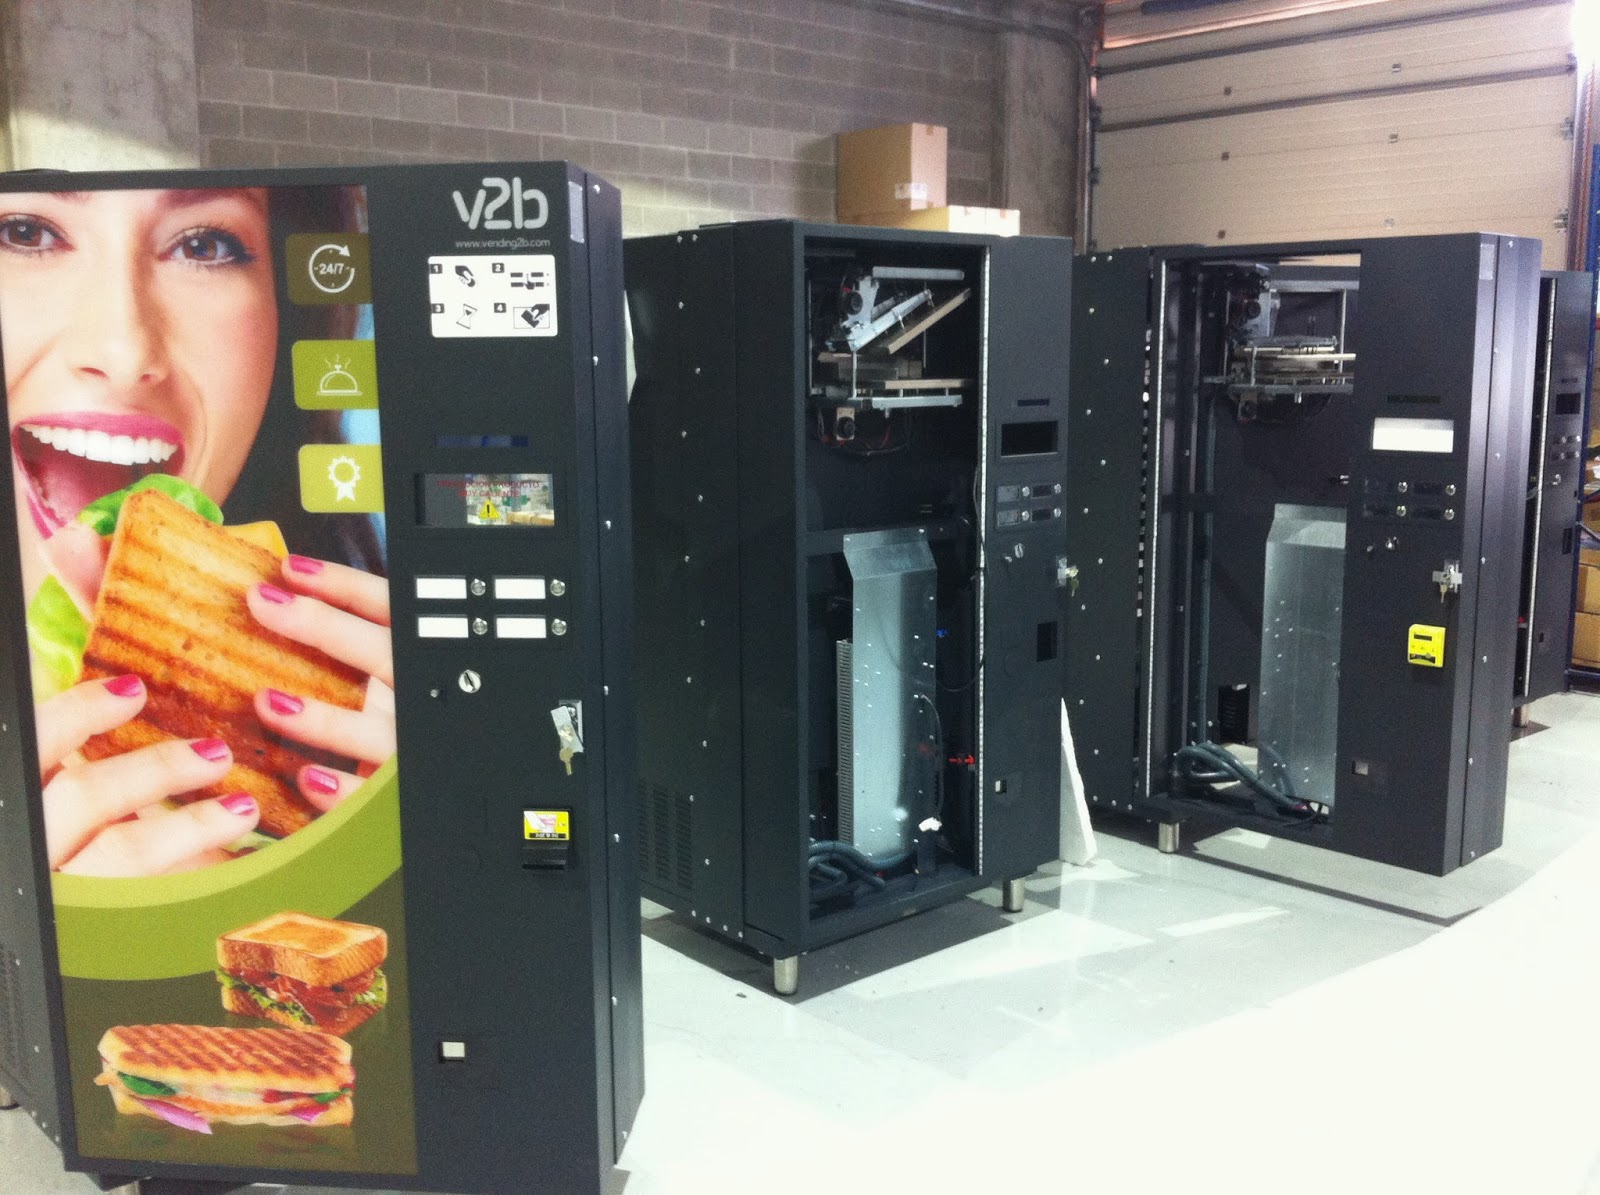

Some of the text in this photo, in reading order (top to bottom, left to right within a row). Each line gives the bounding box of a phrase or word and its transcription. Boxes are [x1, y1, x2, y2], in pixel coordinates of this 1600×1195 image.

[452, 176, 549, 230] v2b
[455, 237, 551, 250] www.vending2b.com
[319, 263, 344, 275] 24/7
